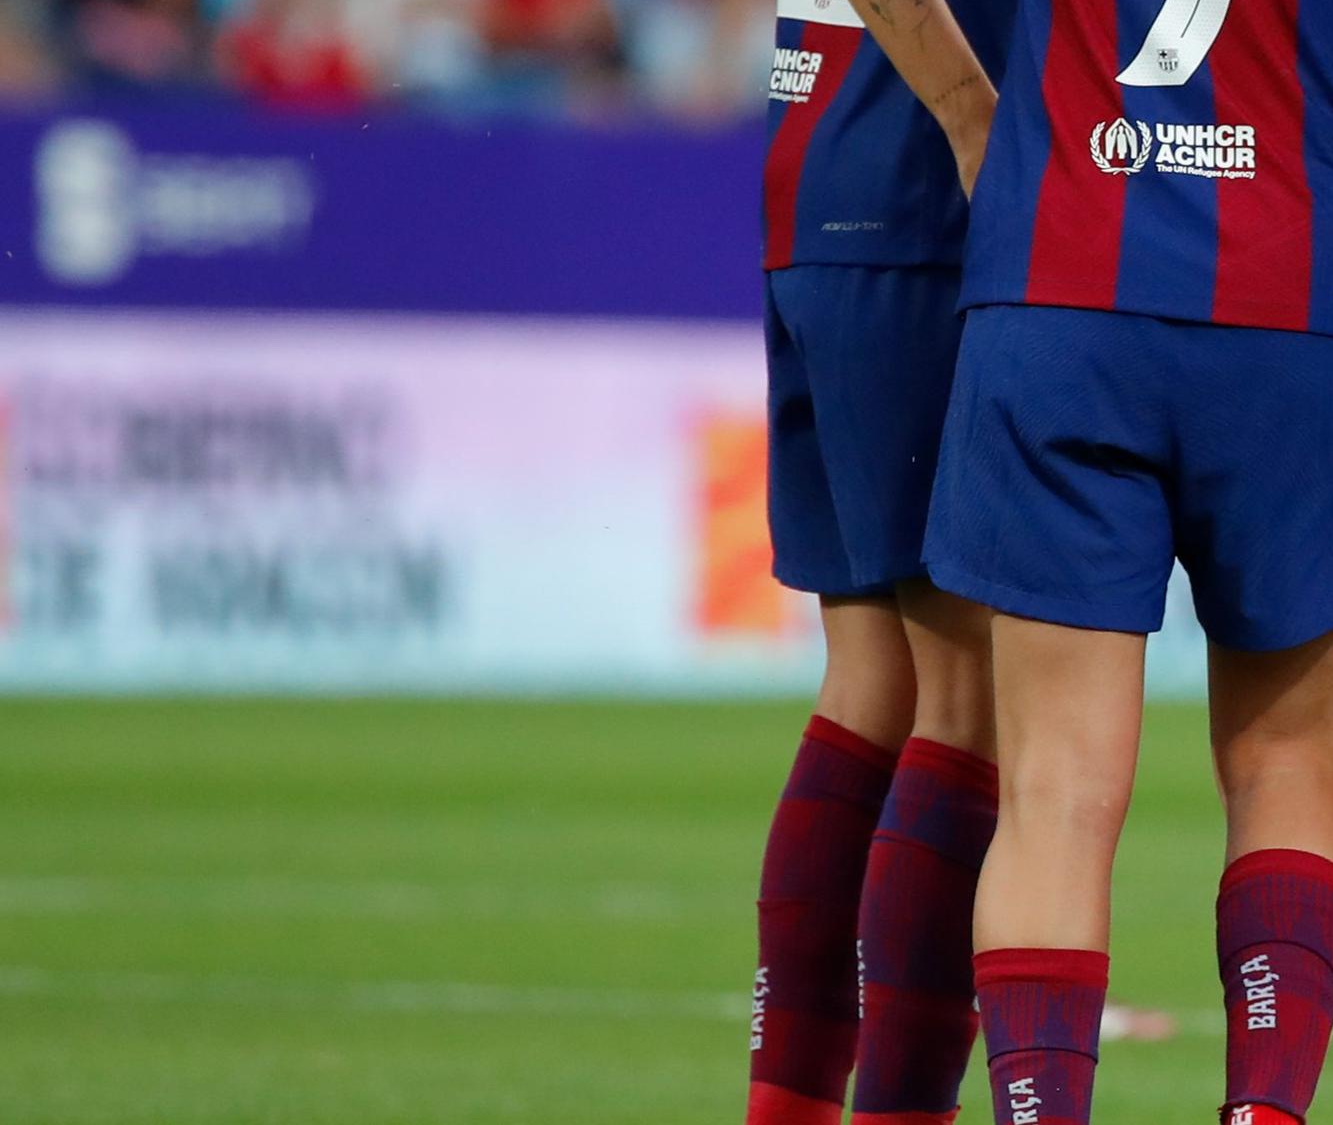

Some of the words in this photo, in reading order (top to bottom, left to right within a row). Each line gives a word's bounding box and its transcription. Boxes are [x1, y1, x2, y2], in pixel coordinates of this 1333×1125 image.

[772, 48, 823, 73] NHCR
[769, 69, 817, 94] CNUR
[1155, 123, 1256, 147] UNHCR
[1155, 144, 1256, 168] ACNUR
[1156, 163, 1173, 172] The
[1173, 164, 1187, 174] UN
[1187, 165, 1222, 178] Refugee
[1223, 169, 1256, 180] Agency
[1240, 954, 1280, 1030] BARÇA
[1008, 1077, 1042, 1125] RÇA
